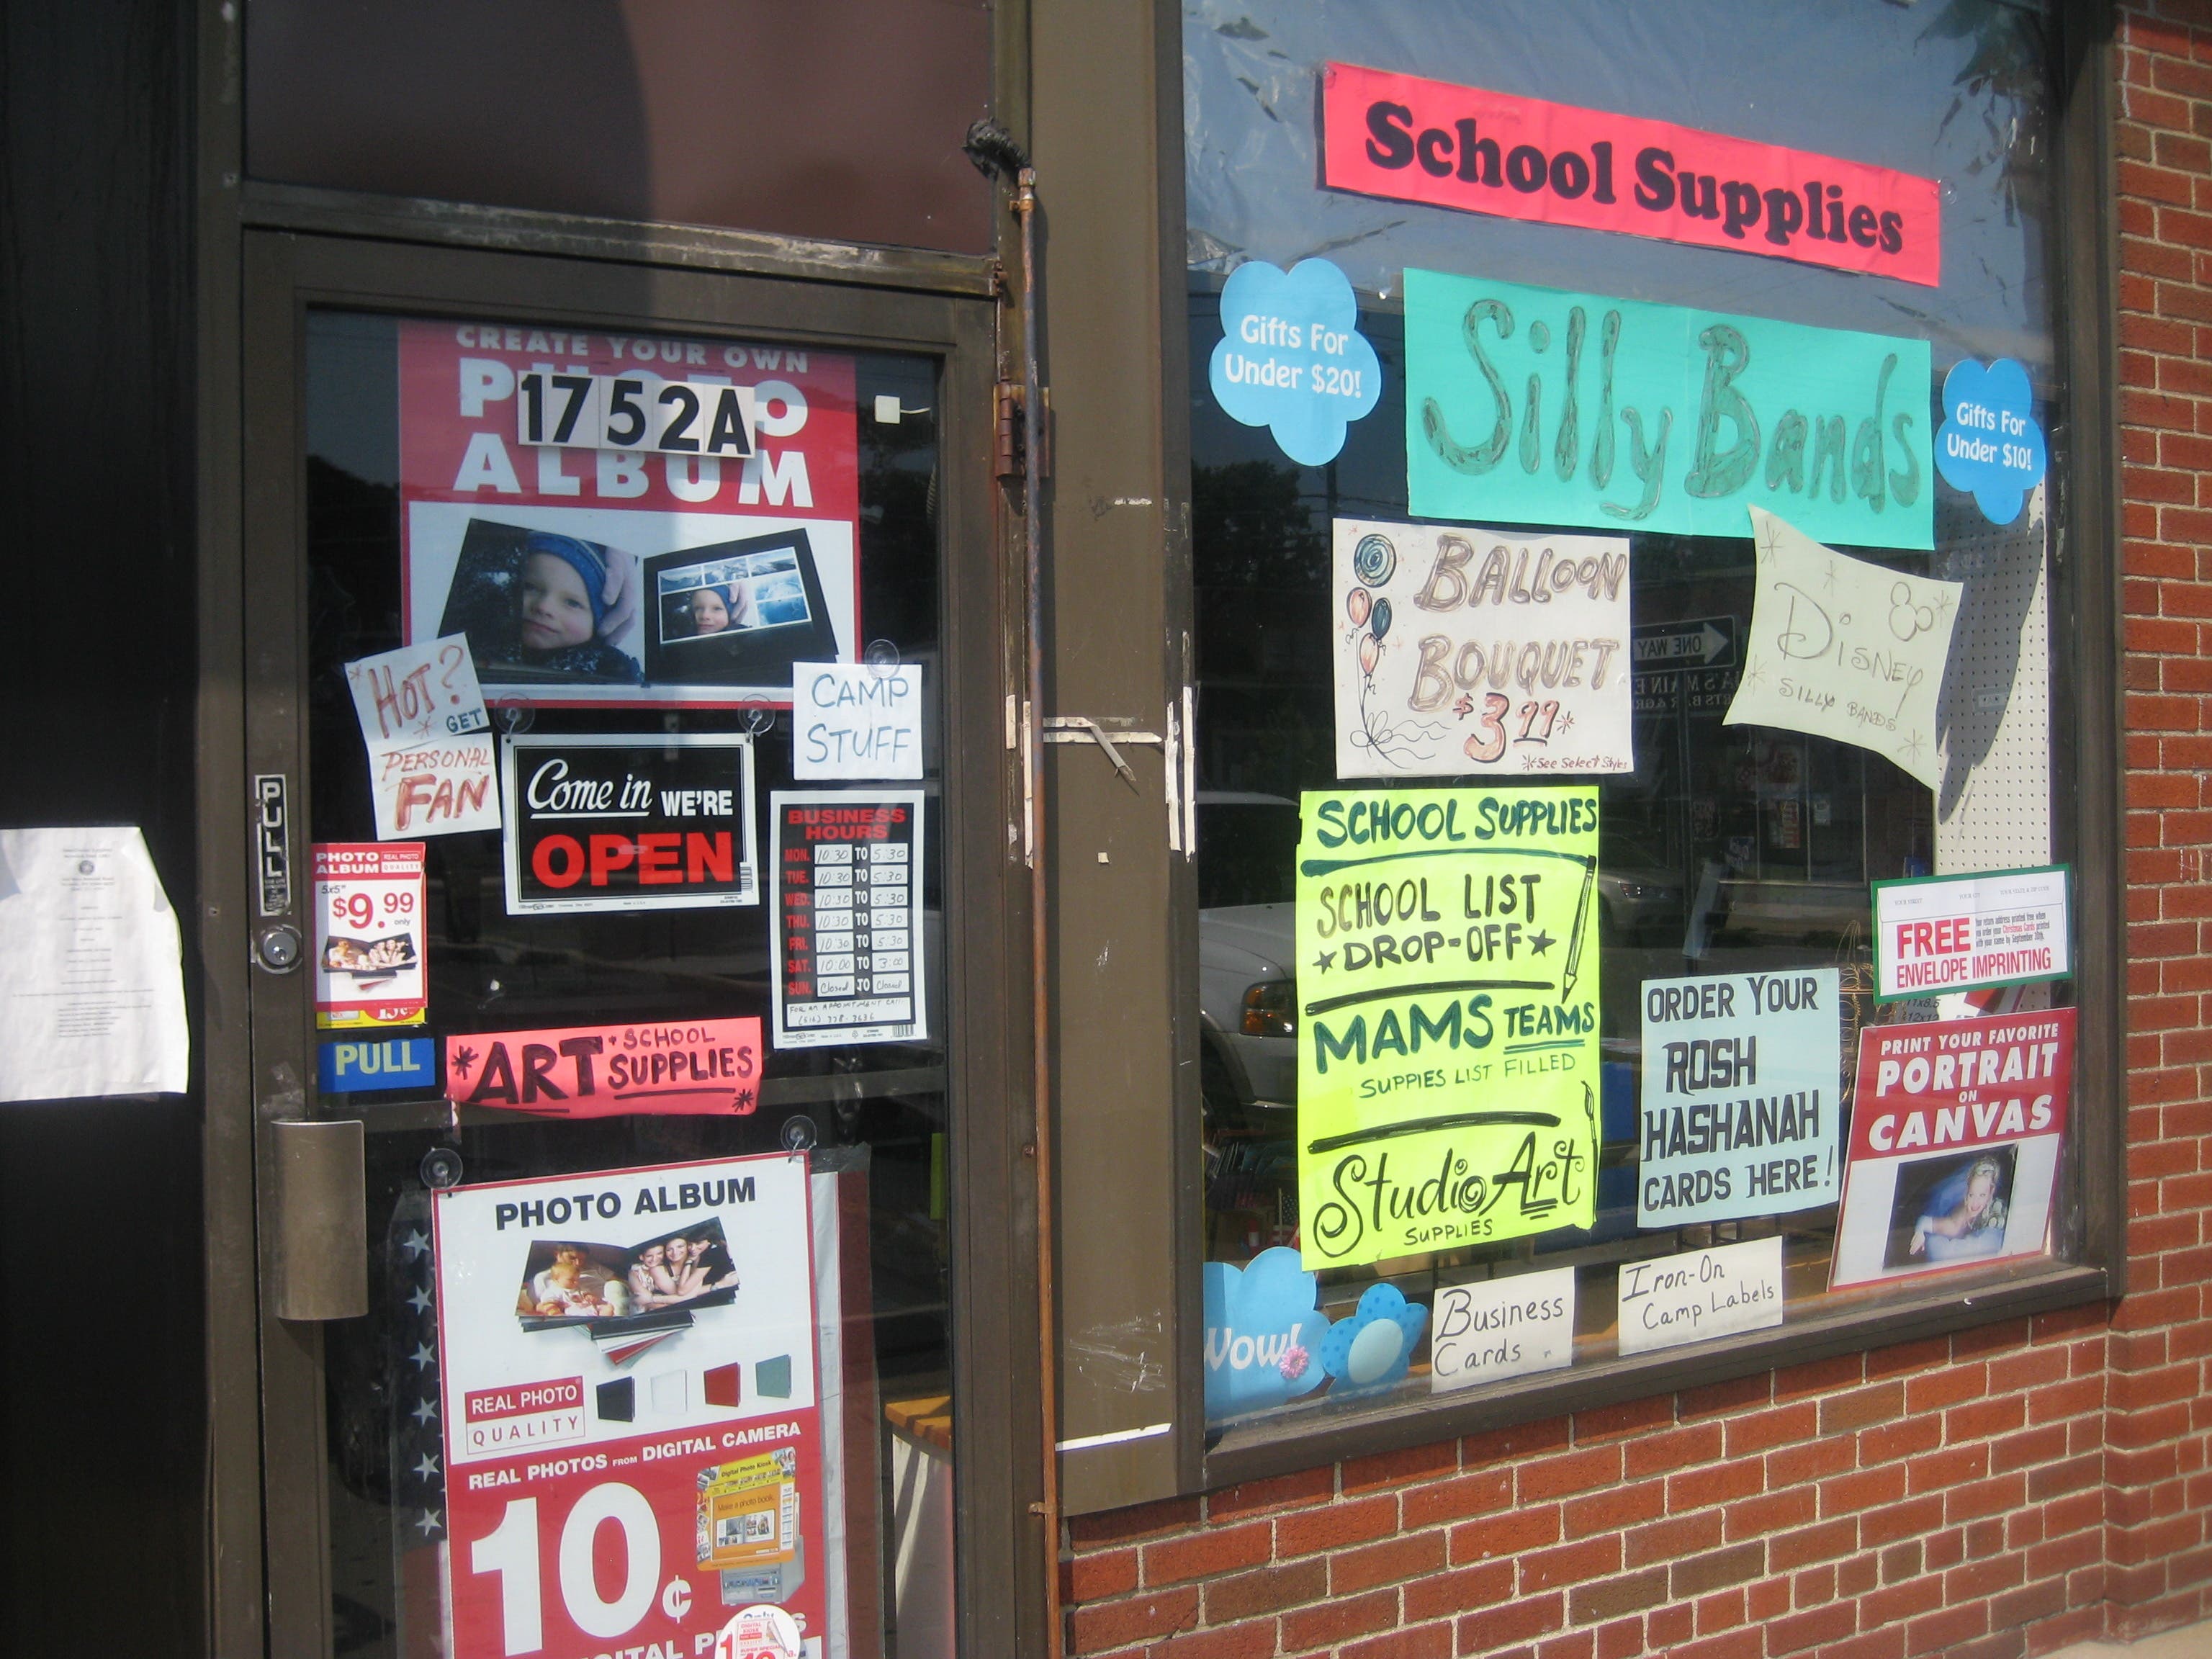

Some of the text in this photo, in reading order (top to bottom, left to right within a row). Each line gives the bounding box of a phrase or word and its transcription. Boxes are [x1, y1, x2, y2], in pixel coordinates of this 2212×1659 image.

[1364, 100, 1903, 255] School Supplies
[457, 327, 808, 374] CREATE YOUR OWN
[1241, 315, 1348, 356] Gifts For
[1225, 354, 1362, 398] Under $20!
[521, 374, 752, 454] 1752A
[1420, 298, 1921, 523] Silly Bands
[1956, 402, 2026, 437] Gifts For
[452, 433, 813, 508] ALBUM
[1947, 433, 2032, 472] Under $10!
[1413, 533, 1627, 612] BALLOON
[811, 673, 909, 707] CAMP
[1408, 633, 1619, 712] BOUQUET
[446, 708, 482, 733] GET
[1779, 678, 1896, 731] SILLY BANDS
[379, 747, 489, 781] PERSONAL
[806, 723, 911, 763] STUFF
[1561, 755, 1599, 768] Select
[395, 773, 489, 831] FAN
[526, 759, 732, 816] Come in WE'RE
[261, 781, 282, 877] PULL
[788, 808, 906, 824] BUSINESS
[805, 824, 888, 840] HOURS
[1317, 797, 1596, 848] SCHOOL SUPPLIES
[315, 852, 379, 862] PHOTO
[315, 864, 379, 874] ALBUM
[532, 832, 733, 889] OPEN
[785, 849, 810, 862] MON.
[855, 847, 868, 860] TO
[873, 849, 905, 860] 5:30
[786, 870, 809, 884] TUE.
[855, 868, 868, 882] TO
[873, 871, 902, 883] 5:30
[784, 892, 810, 906] WED.
[855, 891, 868, 904] TO
[874, 894, 904, 905] 5:30
[786, 914, 810, 928] THU.
[855, 912, 868, 926] TO
[875, 914, 902, 925] 5:30
[1317, 874, 1541, 938] SCHOOL LIST
[788, 937, 808, 950] FRI.
[856, 935, 868, 948] TO
[877, 935, 902, 947] 5:30
[1344, 923, 1521, 971] DROP-OFF
[1897, 917, 1971, 960] FREE
[1995, 915, 2010, 925] address
[2002, 925, 2023, 934] Christmas
[788, 959, 811, 973] SAT.
[857, 956, 869, 969] TO
[878, 958, 903, 968] 3:00
[788, 981, 811, 994] SUN.
[876, 979, 902, 991] Closed
[1897, 947, 2051, 989] ENVELOPE IMPRINTING
[1647, 975, 1819, 1022] ORDER YOUR
[624, 1027, 715, 1049] SCHOOL
[1313, 994, 1595, 1074] MAMS TEAMS
[1881, 1022, 2059, 1056] PRINT YOUR FAVORITE
[335, 1042, 421, 1076] PULL
[468, 1036, 752, 1105] ART SUPPLIES
[1359, 1053, 1575, 1099] SUPPIES LIST FILLED
[1662, 1035, 1756, 1096] ROSH
[1876, 1042, 2059, 1097] PORTRAIT
[1958, 1089, 1978, 1103] ON
[1641, 1089, 1819, 1162] HASHANAH
[1869, 1094, 2053, 1151] CANVAS
[1313, 1132, 1585, 1258] Studio Art
[1644, 1145, 1833, 1212] CARDS HERE!
[495, 1176, 757, 1231] PHOTO ALBUM
[1404, 1219, 1493, 1246] SUPPLIES
[1623, 1254, 1725, 1302] Iron-On
[1436, 1289, 1563, 1342] Business
[1642, 1280, 1775, 1329] Camp Labels
[1434, 1339, 1521, 1377] Cards
[472, 1384, 577, 1416] REAL PHOTO
[473, 1416, 578, 1447] QUALITY
[469, 1421, 801, 1490] REAL PHOTOS FROM DIGITAL CAMERA
[721, 1468, 739, 1478] Digital
[757, 1460, 771, 1468] Kiosk
[739, 1498, 757, 1509] photo
